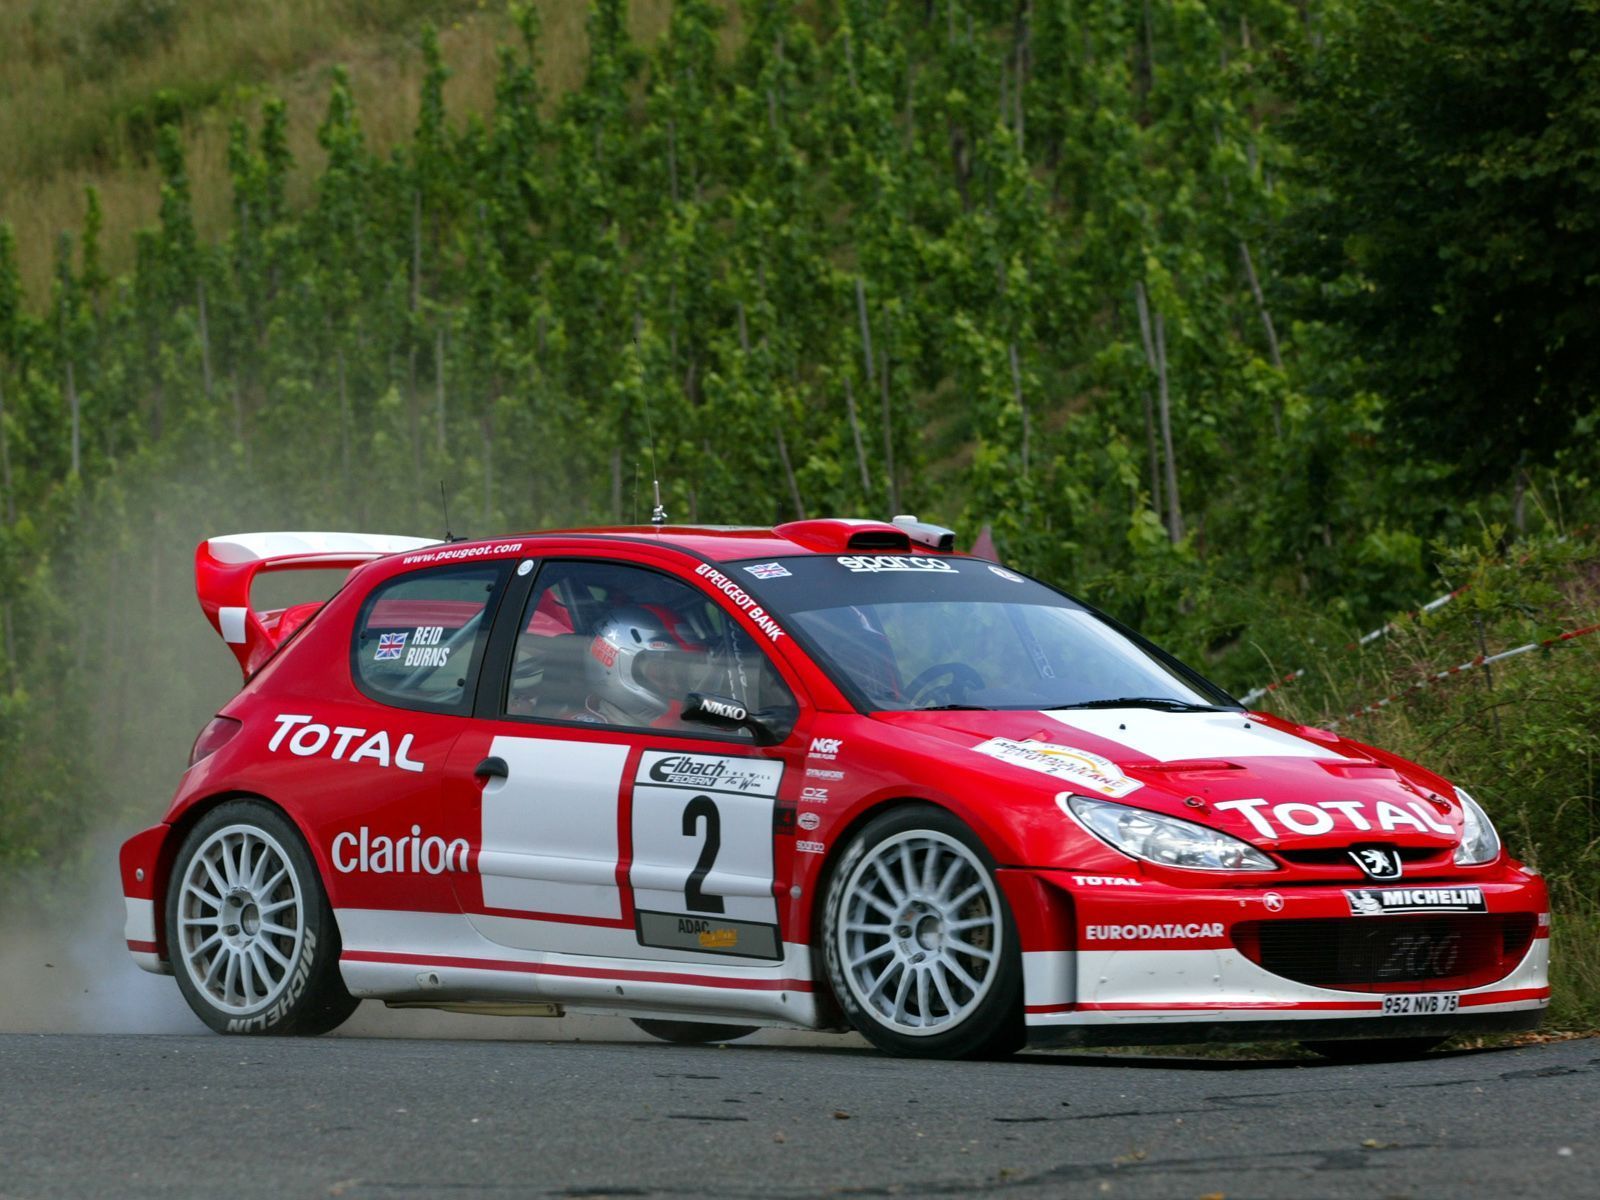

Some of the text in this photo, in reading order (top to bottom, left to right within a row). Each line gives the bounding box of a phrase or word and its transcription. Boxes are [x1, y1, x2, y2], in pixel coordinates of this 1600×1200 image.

[403, 543, 522, 564] www.peugeot.com
[837, 556, 952, 573] sparco
[704, 569, 785, 642] PEUGEOT BANK
[411, 627, 444, 645] REID
[404, 647, 450, 667] BURNS
[700, 699, 747, 721] NIKKO
[268, 714, 425, 772] TOTAL
[809, 737, 843, 753] NGK
[649, 756, 726, 782] Eibach
[665, 775, 713, 787] FEDERN
[1213, 798, 1456, 839] TOTAL
[682, 795, 725, 914] 2
[1072, 876, 1141, 886] TOTAL
[1382, 889, 1482, 906] MICHELIN
[678, 918, 710, 935] ADAC
[1085, 922, 1224, 940] EURODATACAR
[226, 926, 317, 1033] MICHELIN
[1384, 994, 1457, 1013] 952 NVB 75
